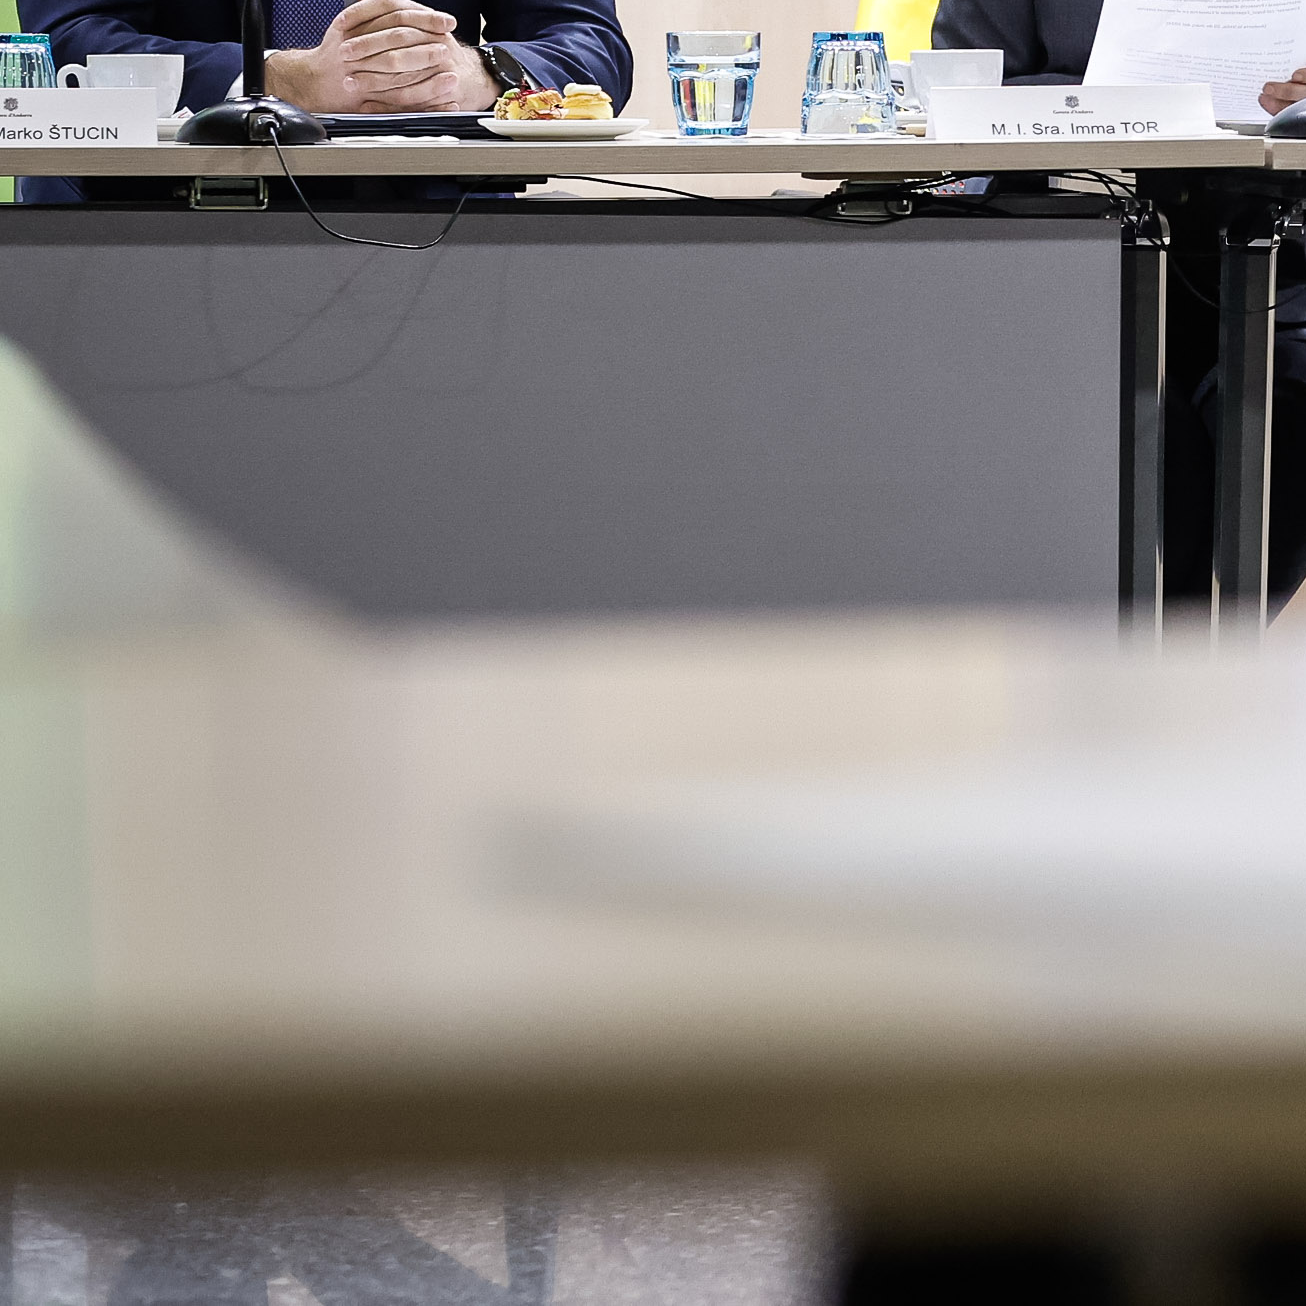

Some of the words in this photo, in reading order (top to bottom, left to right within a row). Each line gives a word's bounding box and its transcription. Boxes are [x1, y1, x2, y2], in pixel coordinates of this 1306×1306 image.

[48, 124, 119, 140] ŠTUCIN
[991, 123, 1012, 136] M.
[1032, 122, 1065, 135] Sra.
[1070, 122, 1116, 134] Imma
[1120, 121, 1160, 134] TOR
